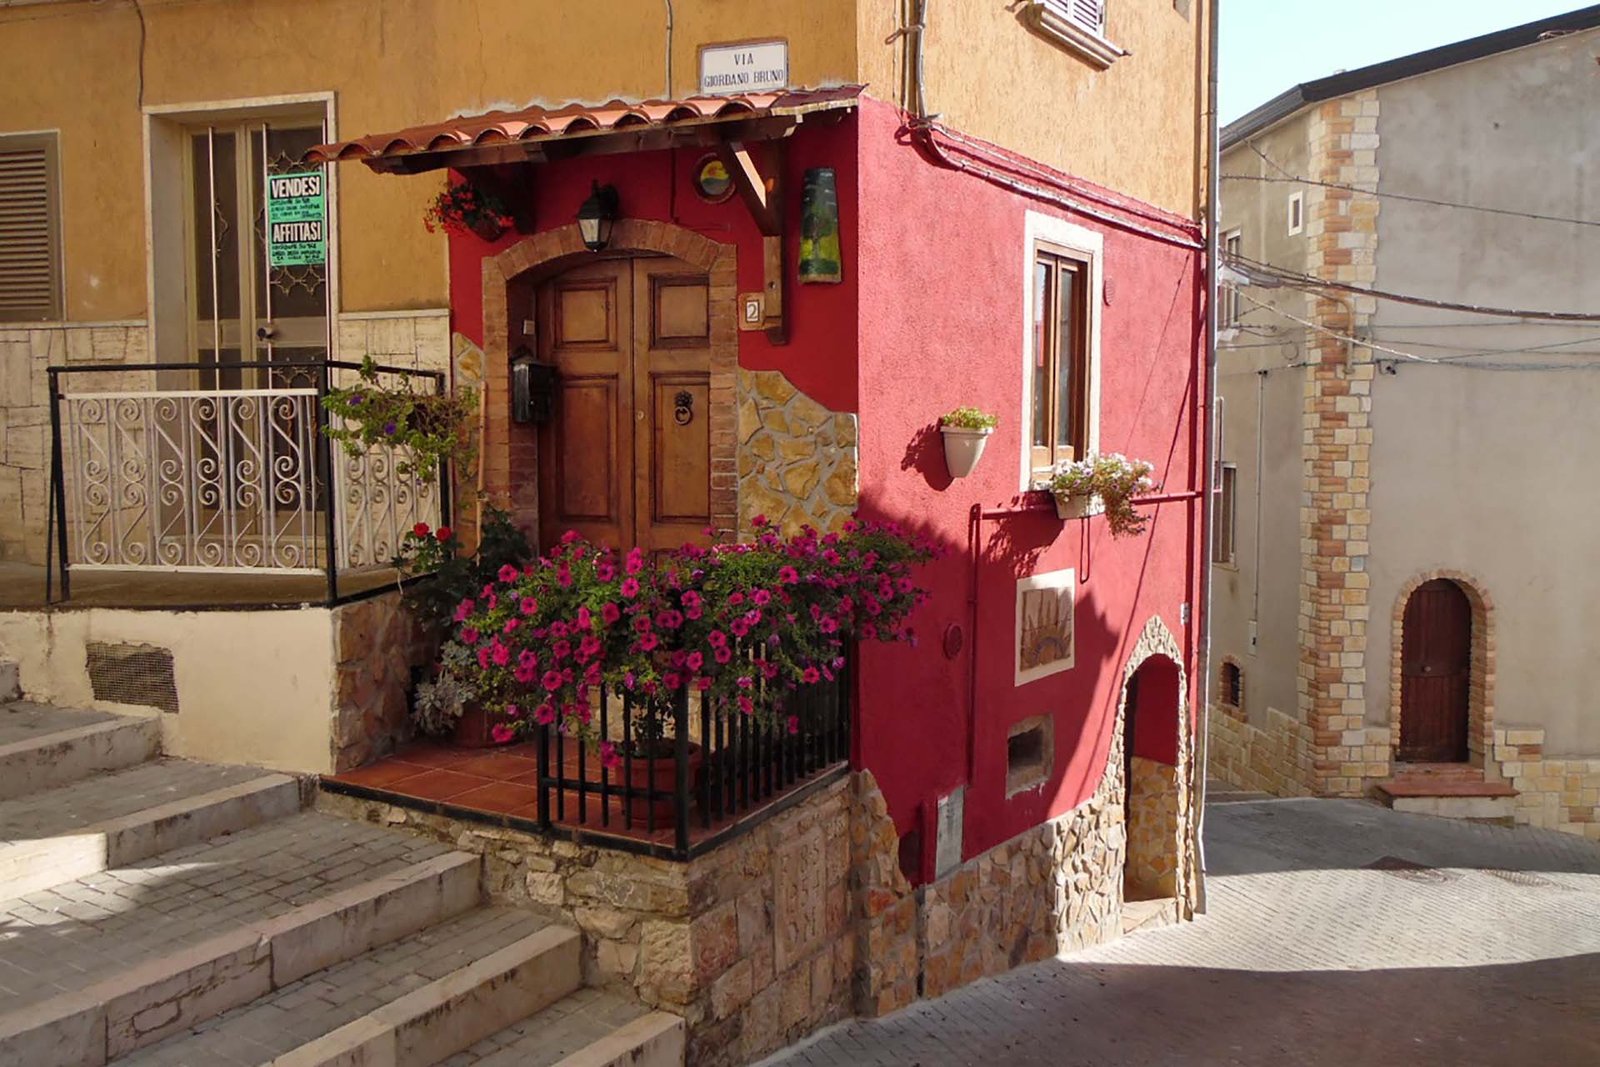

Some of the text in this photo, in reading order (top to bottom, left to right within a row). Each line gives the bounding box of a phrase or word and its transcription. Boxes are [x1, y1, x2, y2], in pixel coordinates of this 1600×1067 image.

[733, 52, 754, 66] VIA
[704, 69, 784, 88] GIORDANO BRUNO
[271, 176, 320, 199] VENDESI
[273, 222, 321, 243] AFFITTASI
[747, 303, 758, 320] 2
